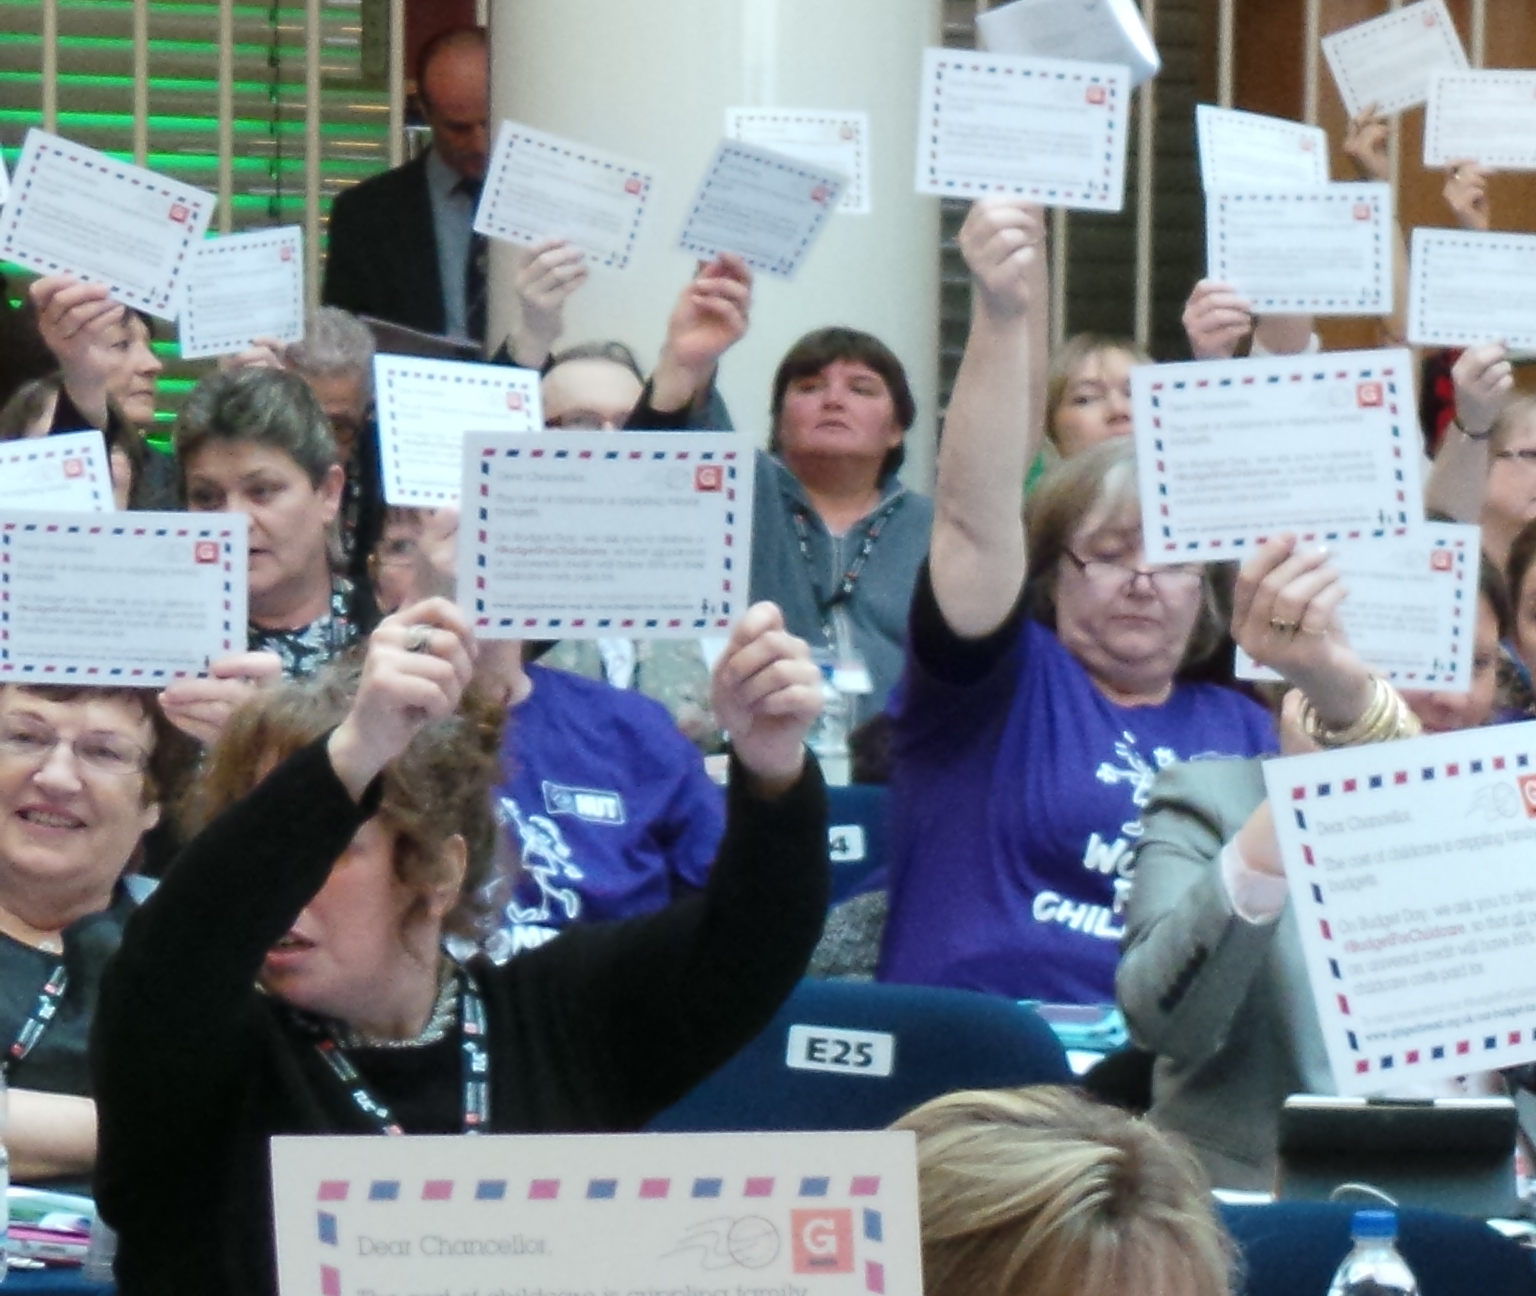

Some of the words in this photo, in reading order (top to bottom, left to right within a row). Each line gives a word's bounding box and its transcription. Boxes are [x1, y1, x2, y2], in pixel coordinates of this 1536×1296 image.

[806, 1037, 873, 1068] E25
[357, 1234, 412, 1256] Dear
[802, 1218, 838, 1256] G
